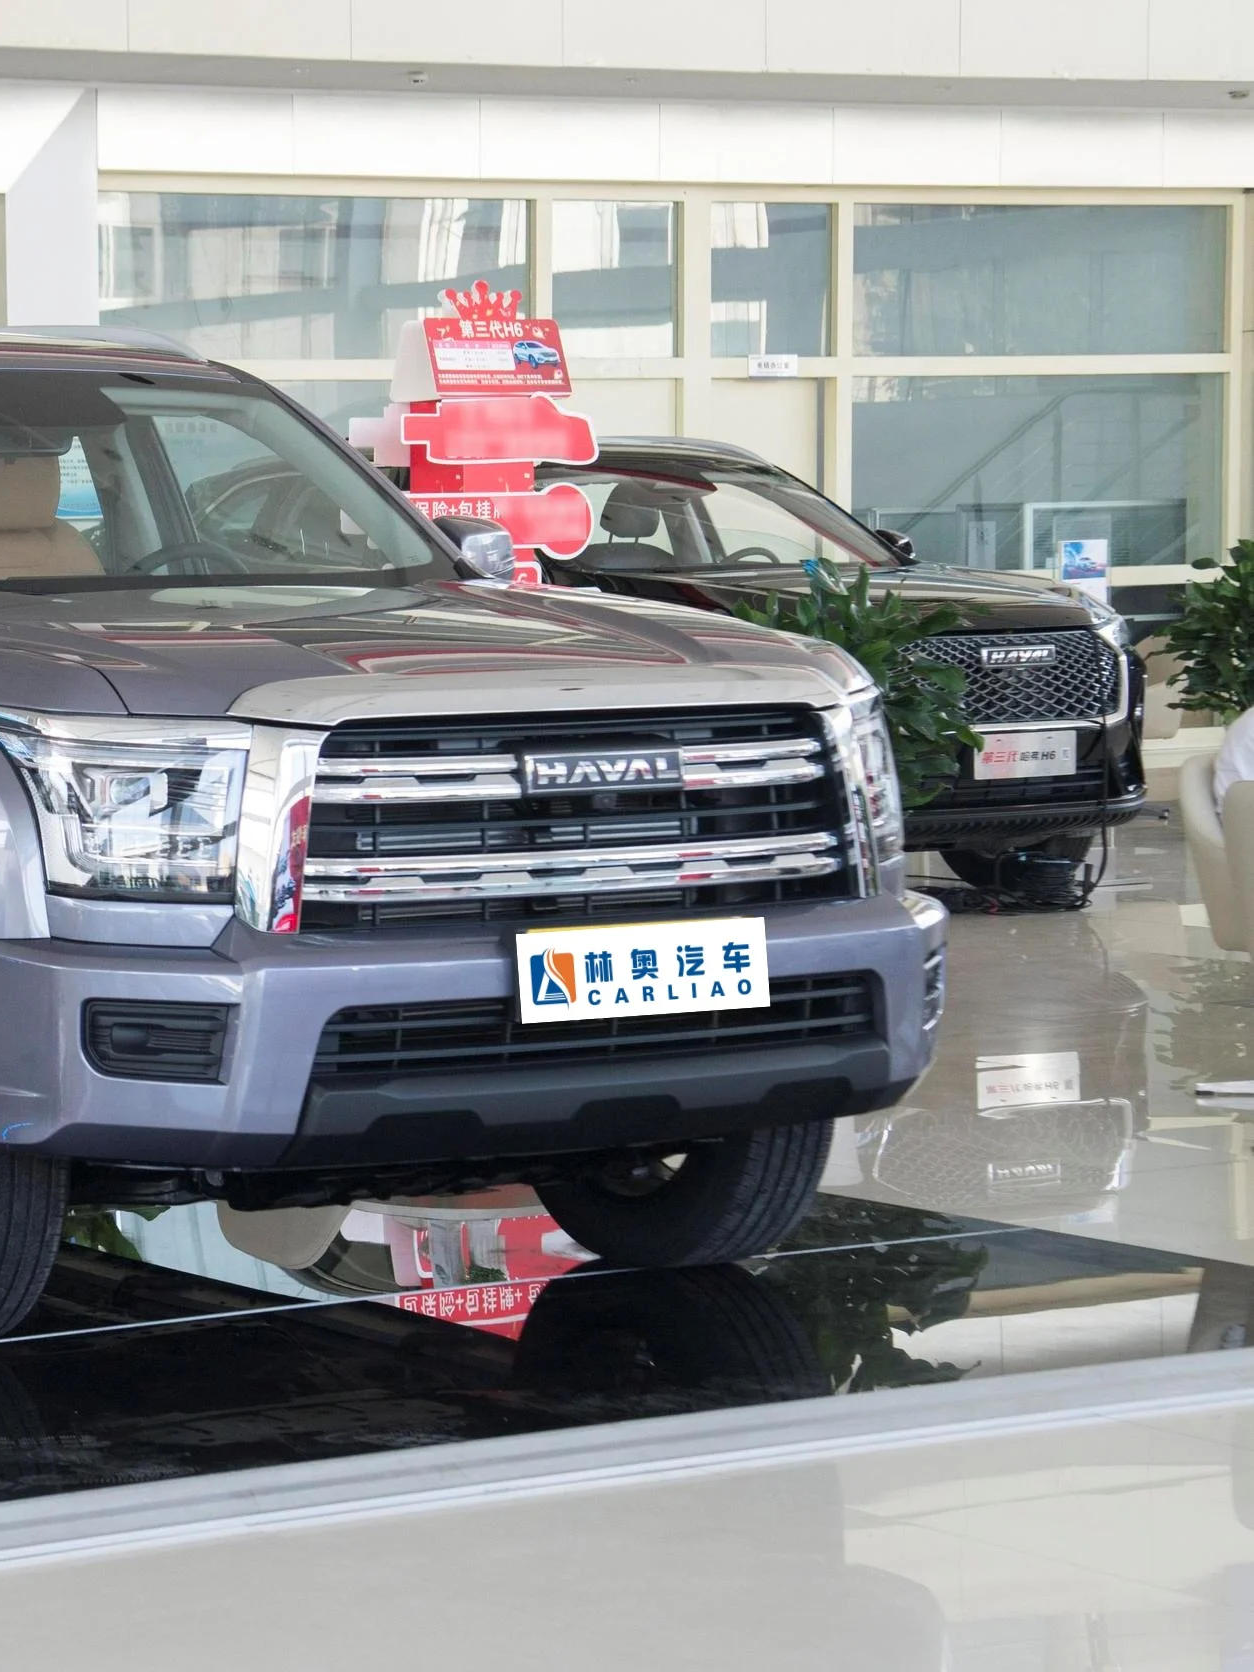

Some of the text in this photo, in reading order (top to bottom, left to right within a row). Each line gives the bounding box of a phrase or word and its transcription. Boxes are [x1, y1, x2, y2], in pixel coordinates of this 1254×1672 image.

[458, 320, 524, 339] 第三代H6
[990, 649, 1052, 664] HAVAL
[534, 756, 679, 786] HAVAL
